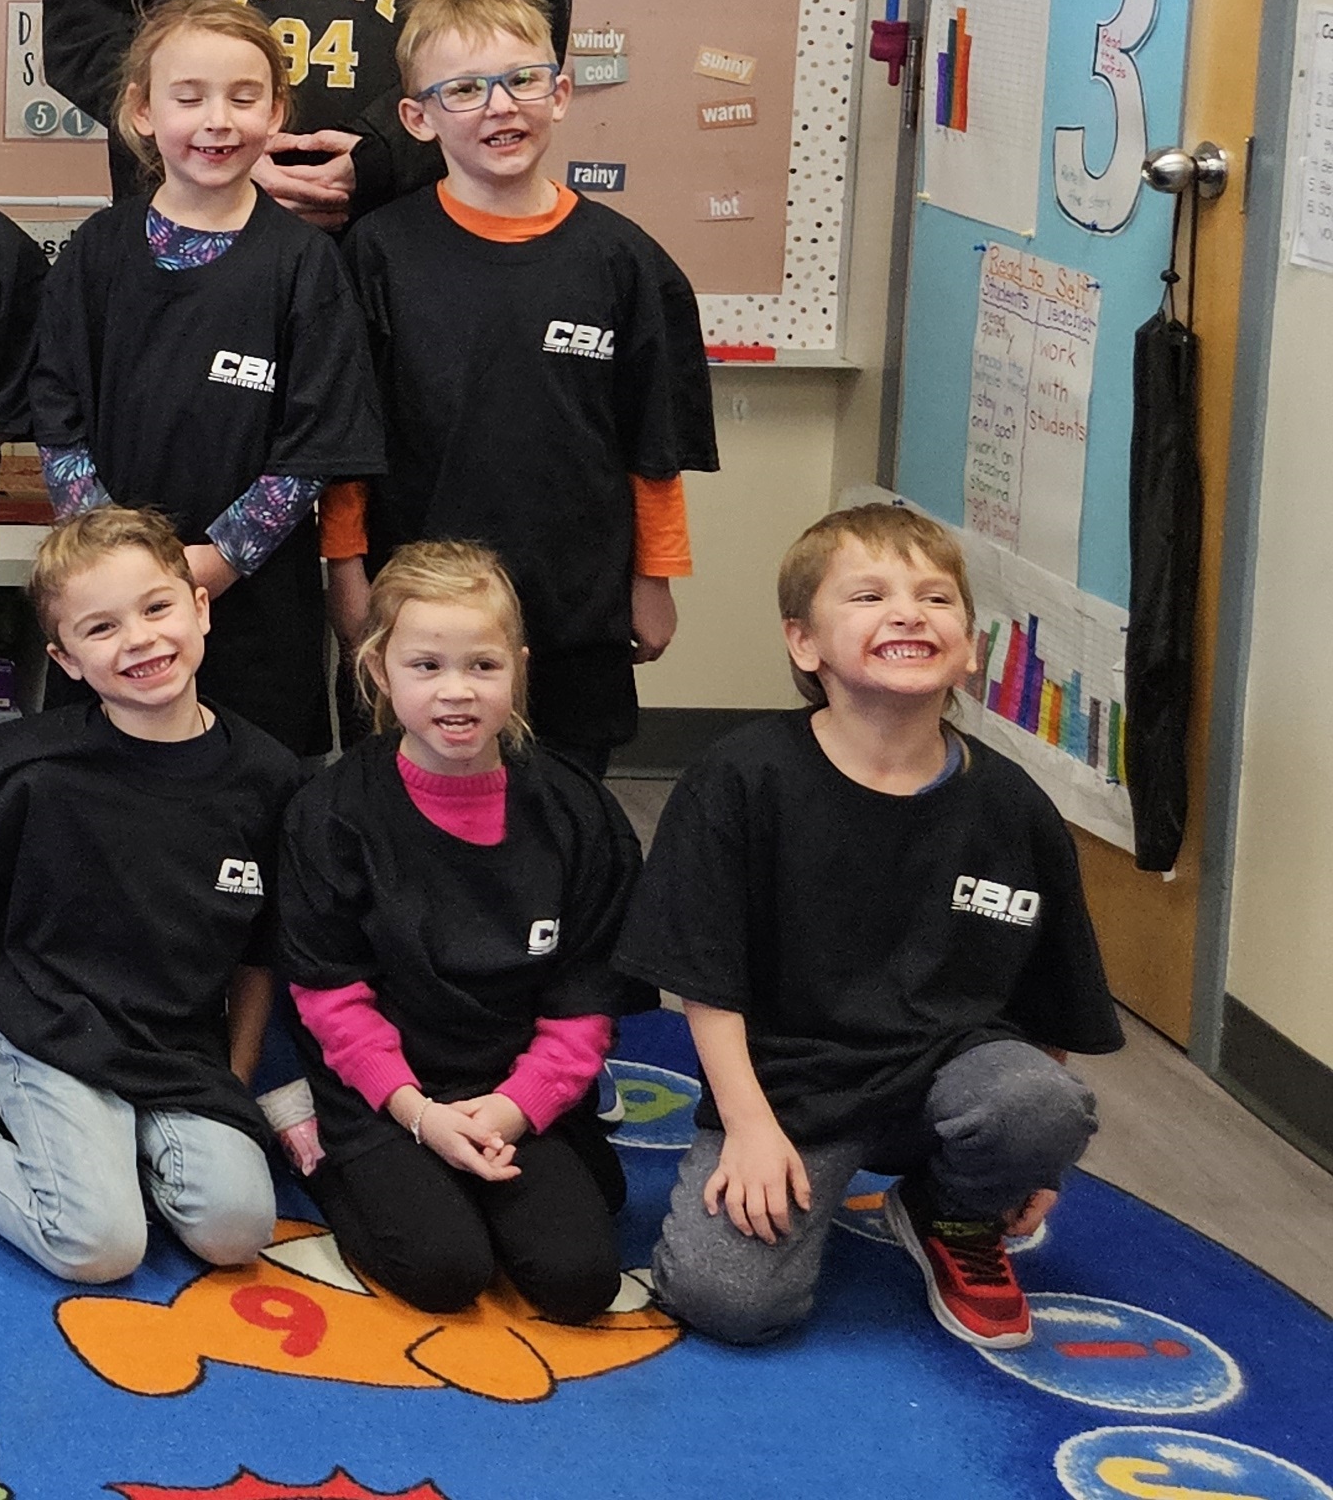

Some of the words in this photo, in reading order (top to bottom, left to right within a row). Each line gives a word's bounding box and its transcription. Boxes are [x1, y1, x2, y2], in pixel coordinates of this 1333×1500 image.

[269, 17, 359, 88] 94
[573, 28, 625, 53] windy
[585, 59, 617, 81] cool
[699, 50, 752, 80] sunny
[702, 103, 752, 124] warm
[574, 163, 618, 188] rainy
[710, 197, 739, 217] hot
[218, 858, 263, 892] CB
[953, 875, 1040, 922] CBO
[228, 1284, 328, 1358] 9
